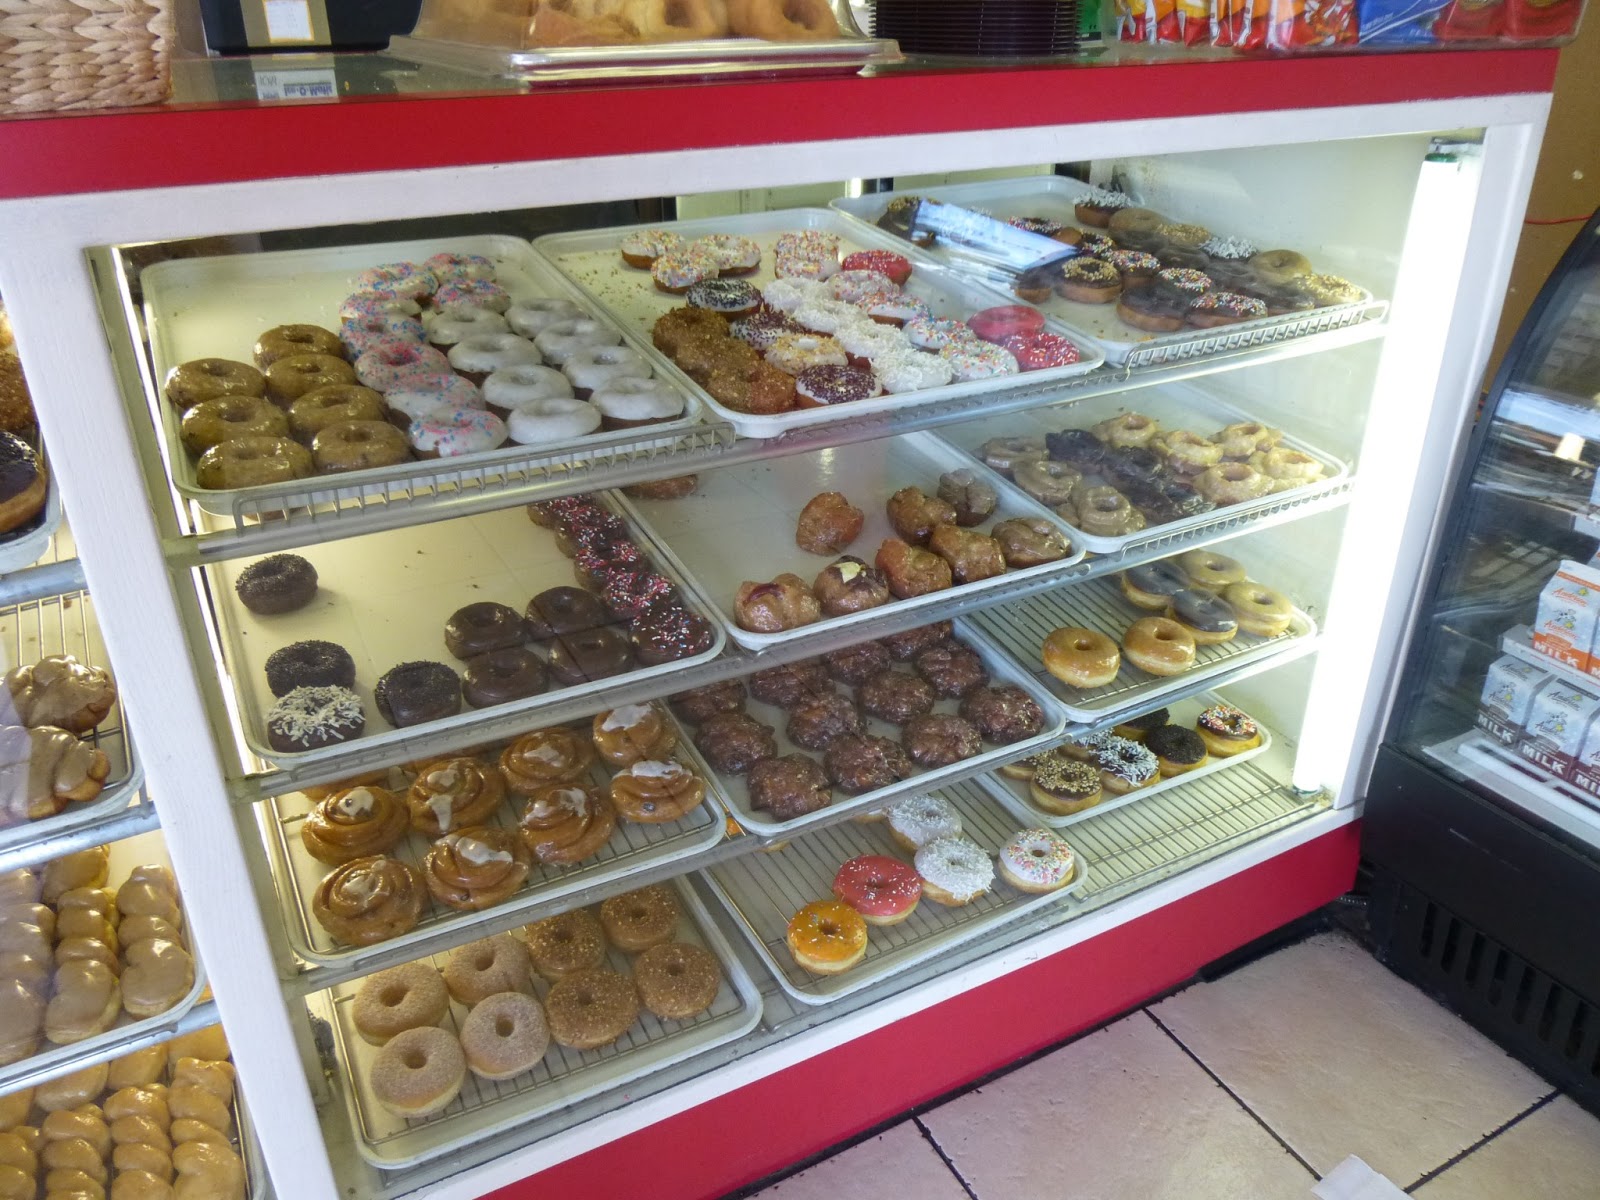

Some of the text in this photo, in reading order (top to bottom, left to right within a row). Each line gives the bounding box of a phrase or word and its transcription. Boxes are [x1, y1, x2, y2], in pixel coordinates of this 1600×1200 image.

[1533, 641, 1579, 668] MILK
[1477, 715, 1514, 744] MILK
[1523, 744, 1565, 776] MILK
